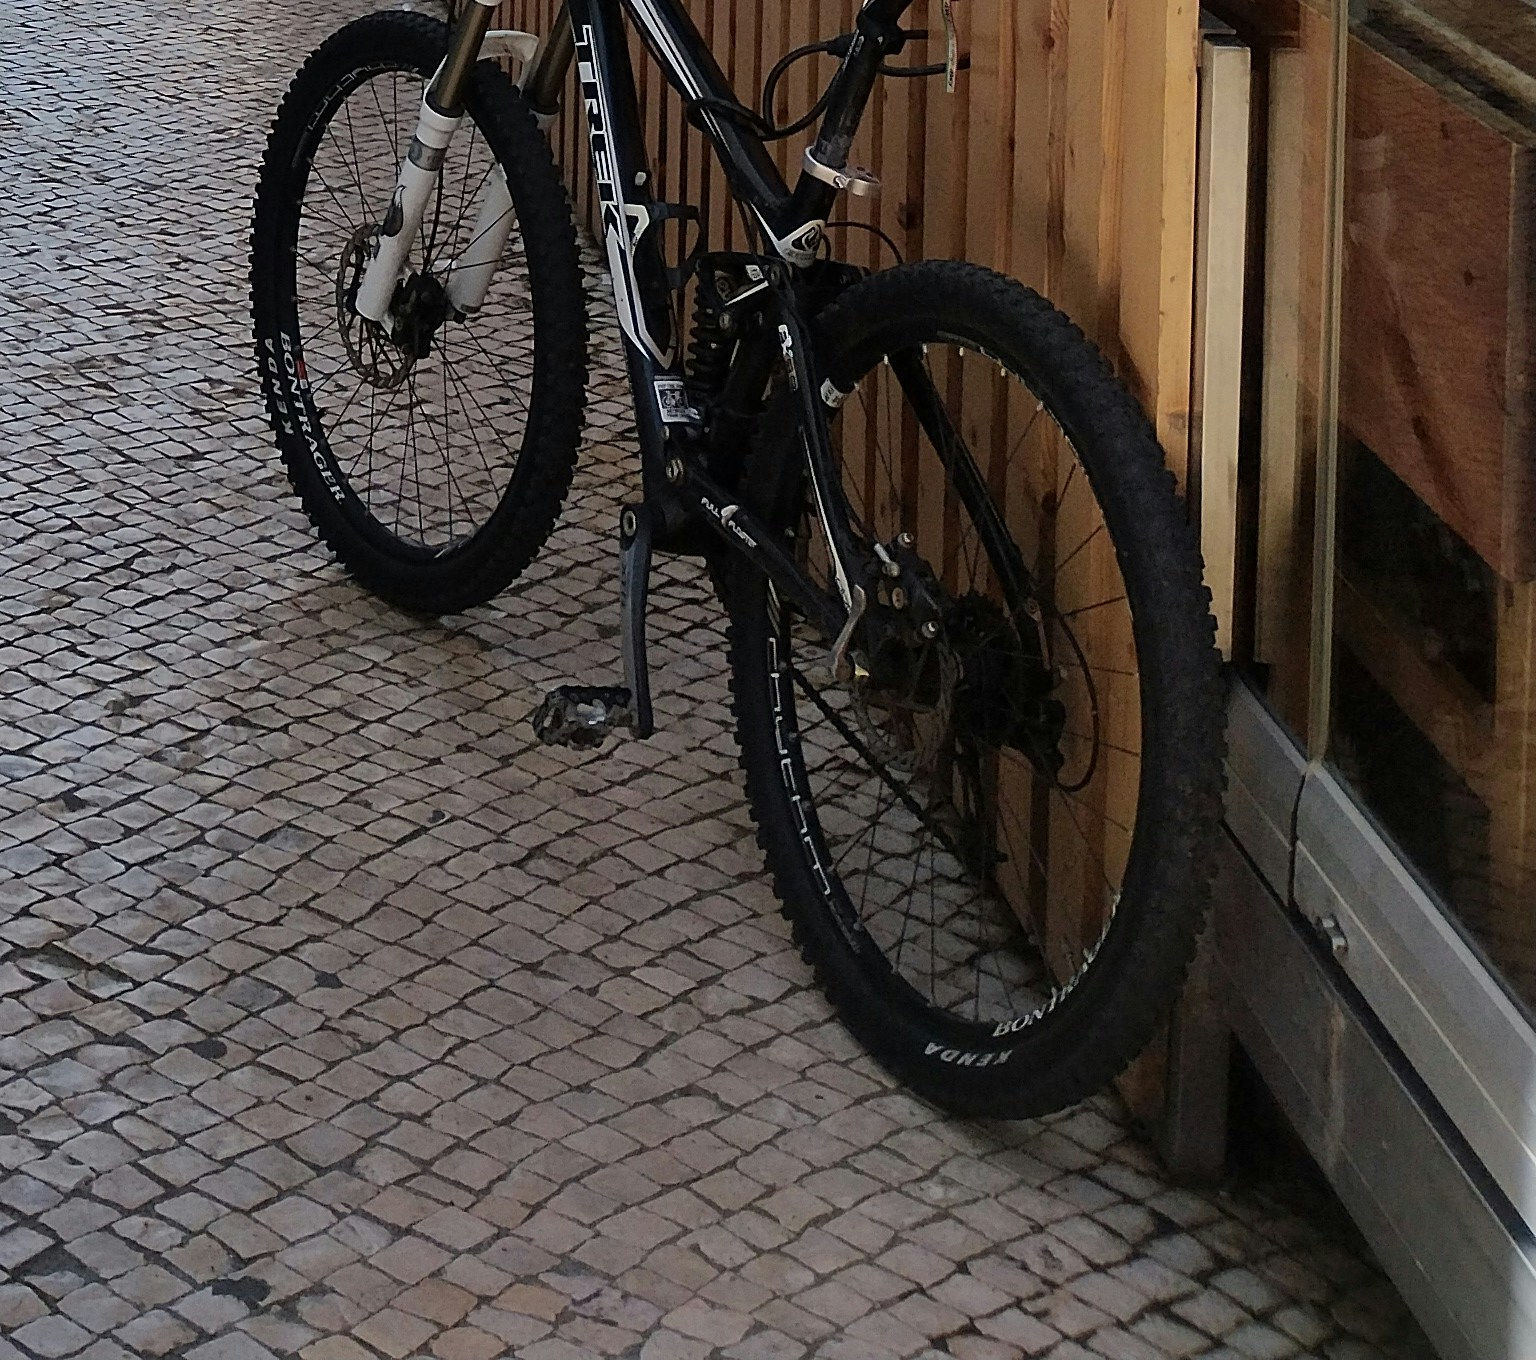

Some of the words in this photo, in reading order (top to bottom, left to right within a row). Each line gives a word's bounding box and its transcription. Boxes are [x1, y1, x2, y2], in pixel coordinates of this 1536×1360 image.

[263, 337, 295, 435] KENDA
[280, 330, 347, 505] BONTRAGER
[924, 1041, 1014, 1068] KENDA
